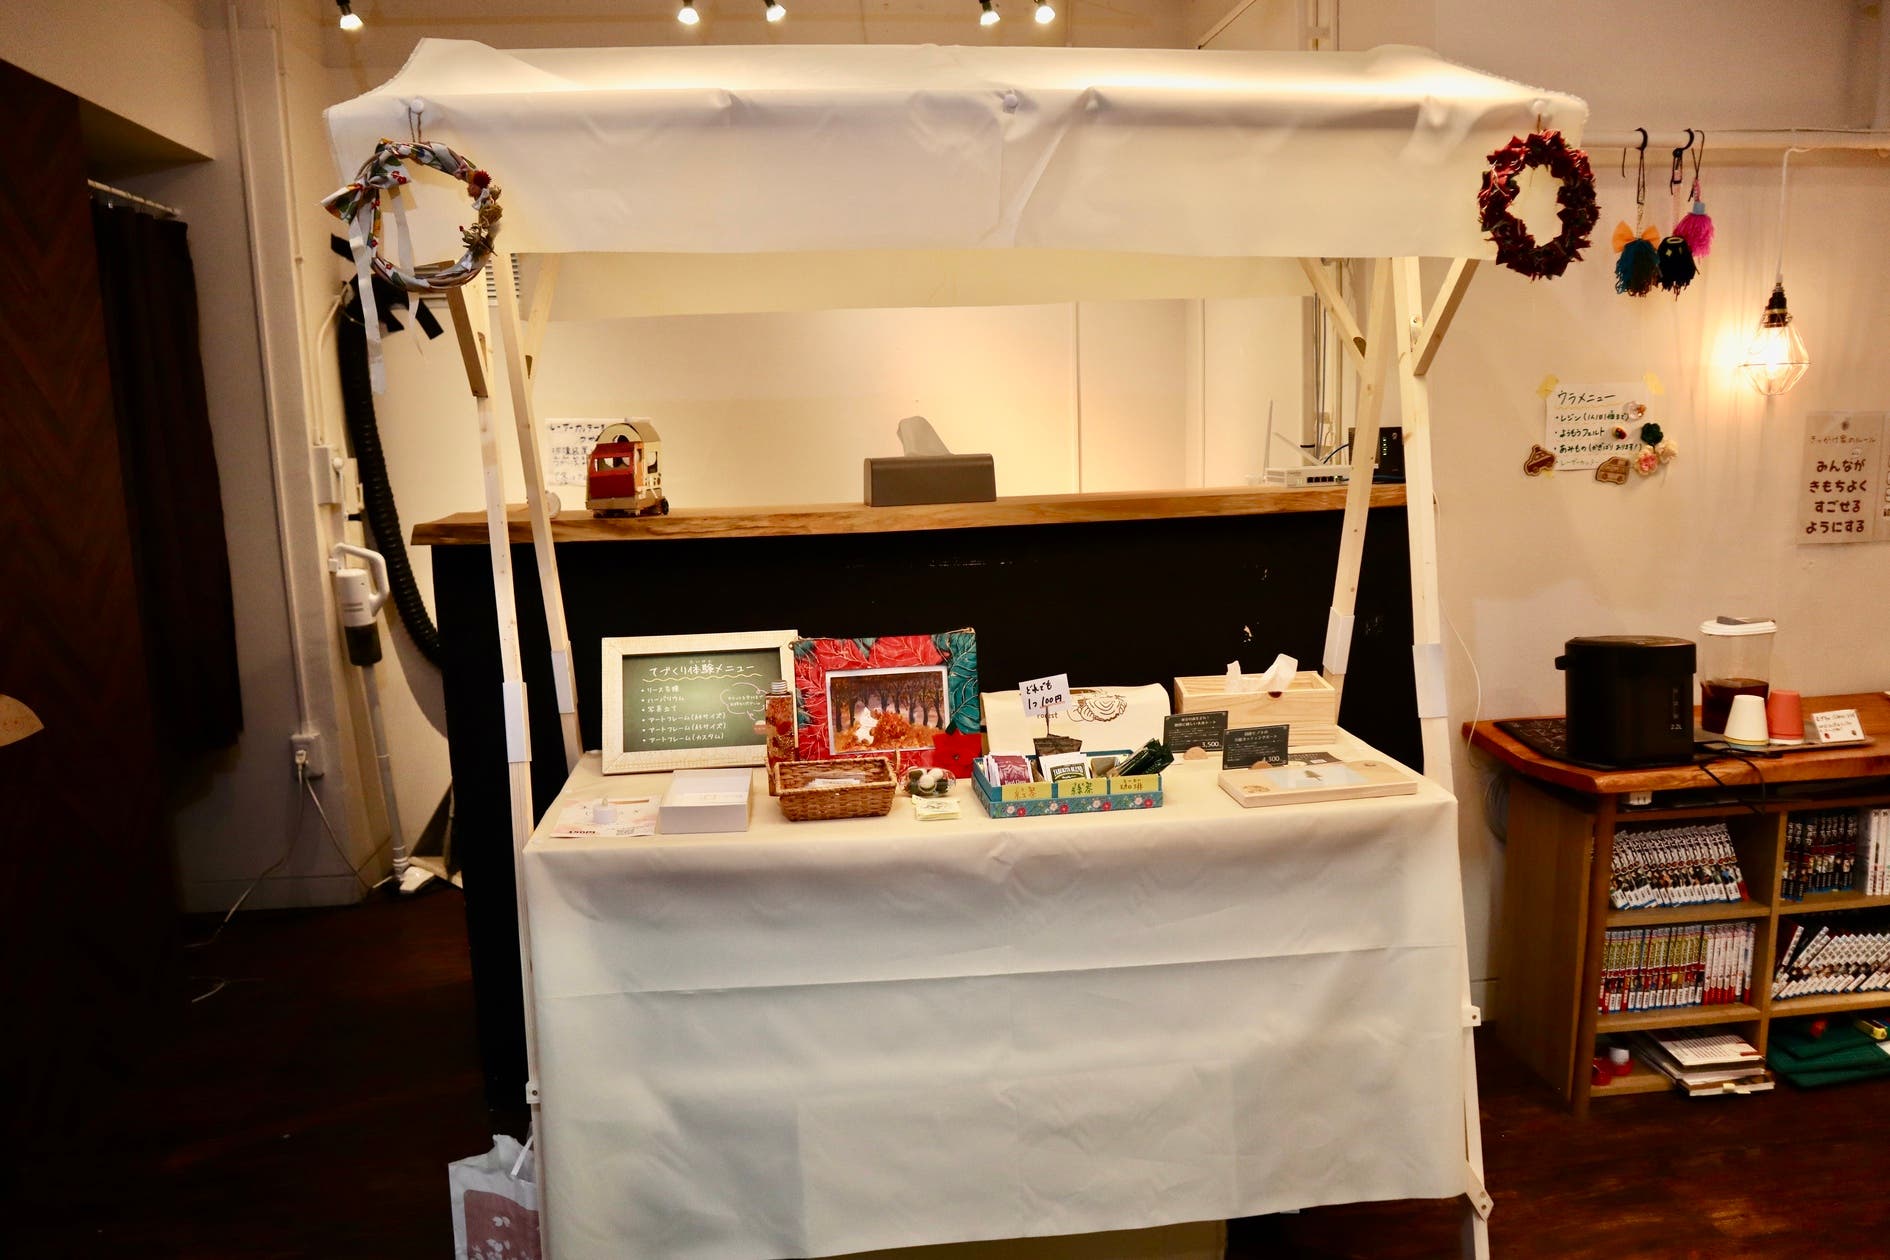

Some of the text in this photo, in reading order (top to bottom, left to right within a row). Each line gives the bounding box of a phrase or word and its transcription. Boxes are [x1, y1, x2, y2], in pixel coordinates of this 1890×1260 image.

[1557, 390, 1617, 405] ウラメニュー
[1816, 459, 1867, 473] みんなが
[1809, 480, 1868, 493] きもちよく
[1814, 499, 1861, 513] すごせる
[1805, 519, 1865, 534] ようにする
[649, 664, 755, 677] てづくり体験メニュー
[1026, 679, 1053, 695] どれでも
[1041, 694, 1062, 707] 100円
